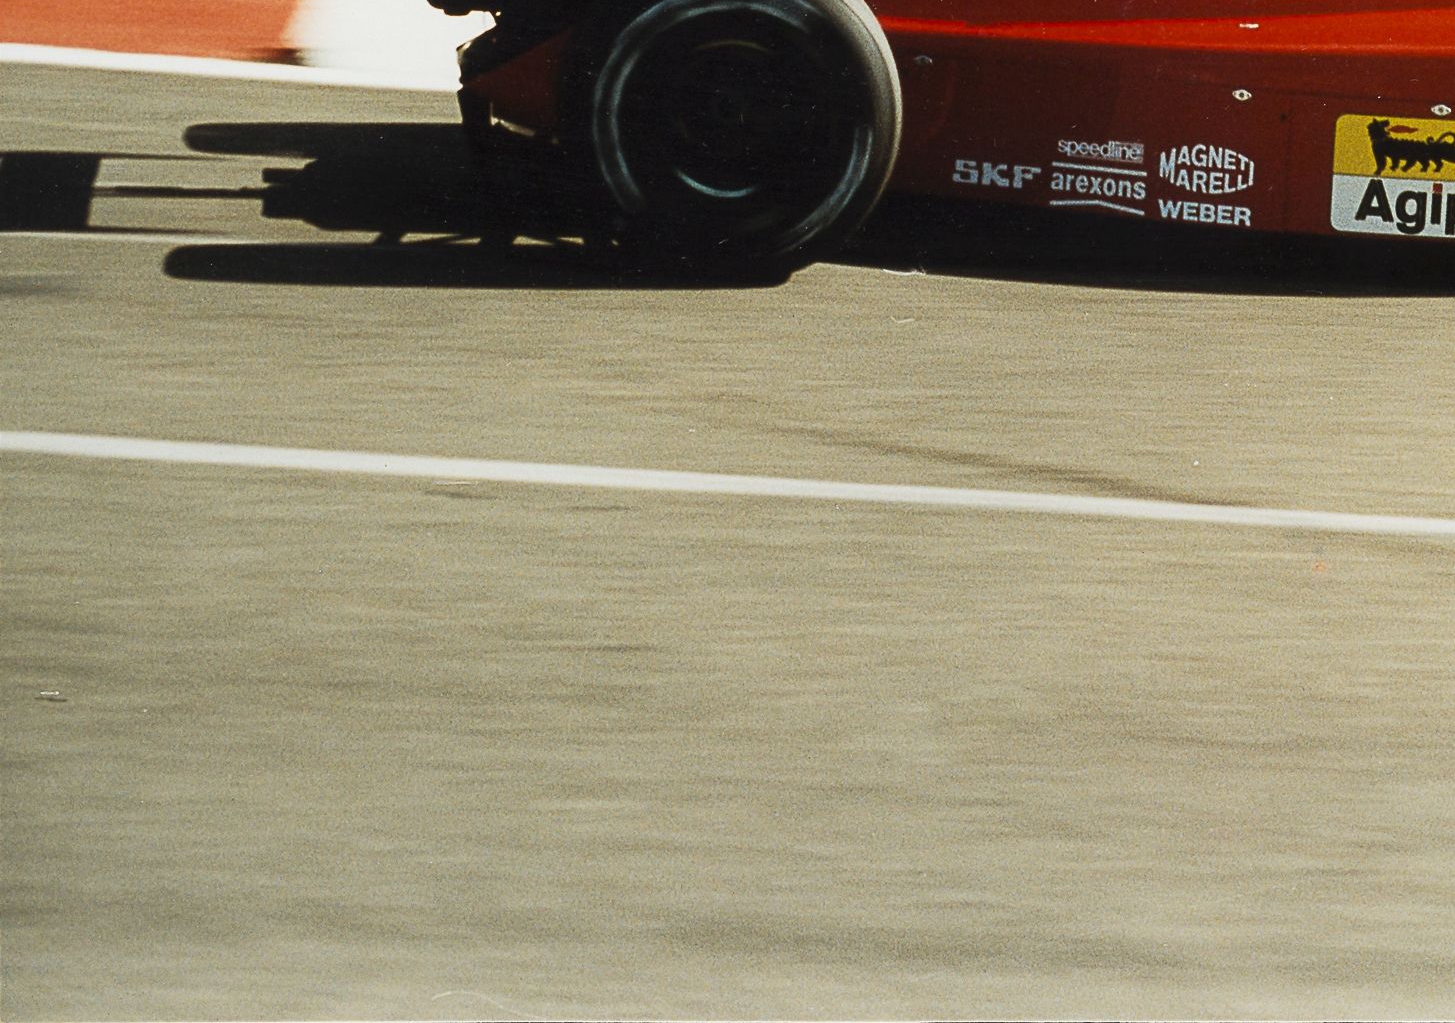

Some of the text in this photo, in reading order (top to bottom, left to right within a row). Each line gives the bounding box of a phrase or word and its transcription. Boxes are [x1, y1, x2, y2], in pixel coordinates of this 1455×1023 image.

[1057, 139, 1143, 162] speedline
[952, 158, 1042, 190] SKF
[1050, 172, 1147, 200] arexons
[1157, 198, 1251, 227] WEBER
